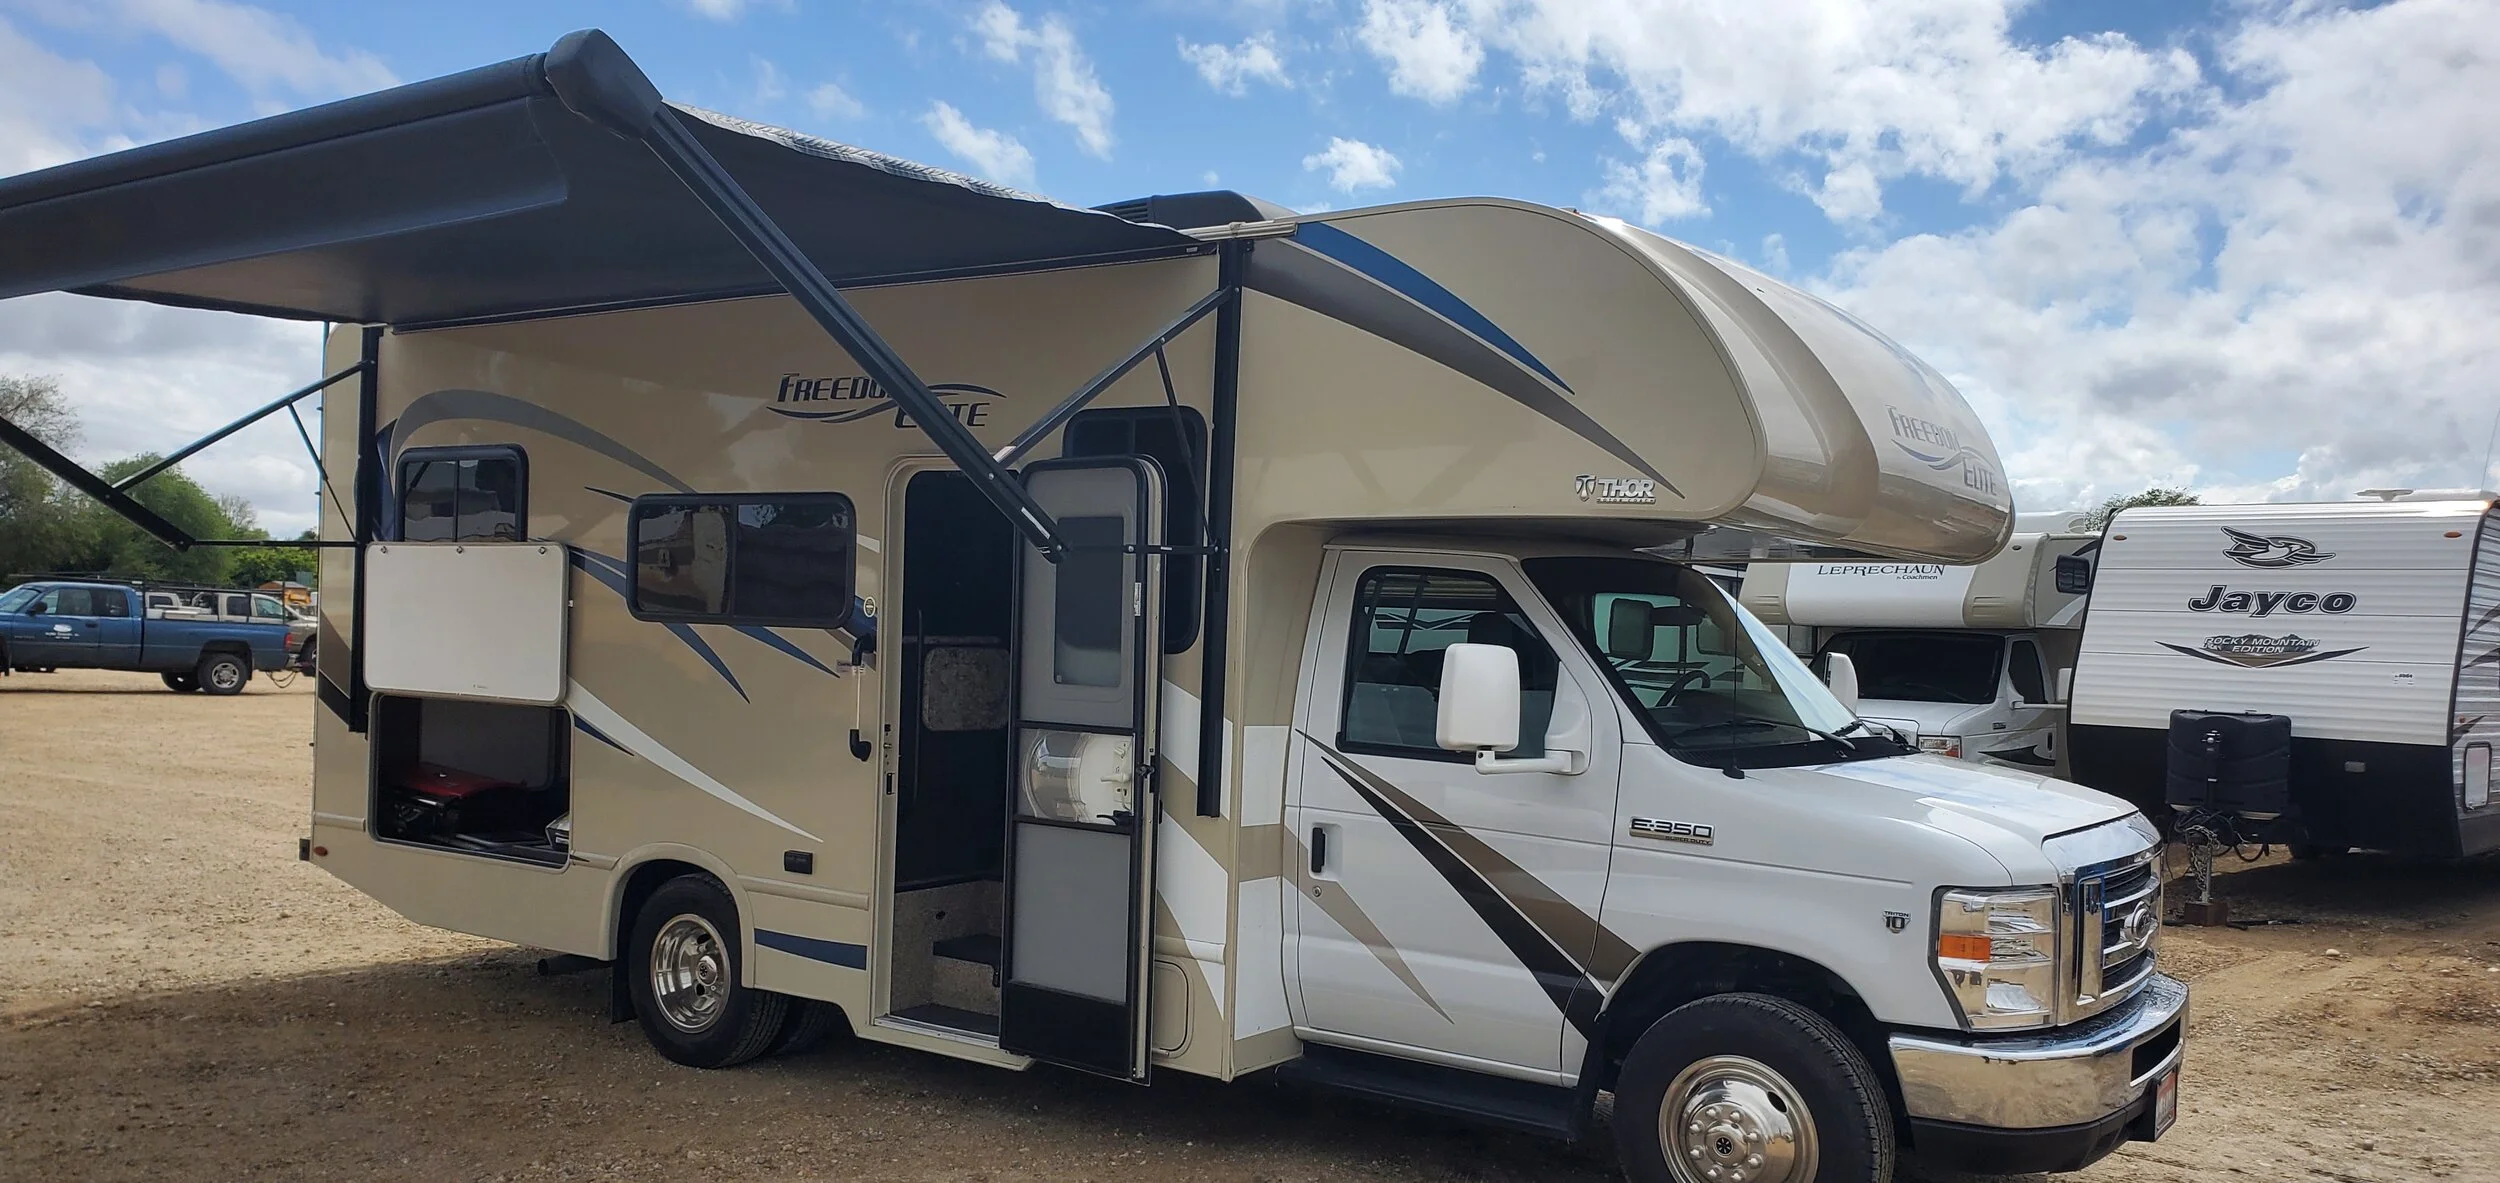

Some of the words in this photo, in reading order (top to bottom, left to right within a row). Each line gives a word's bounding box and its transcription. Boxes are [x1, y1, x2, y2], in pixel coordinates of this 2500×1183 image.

[777, 373, 887, 402] FREEDO
[1884, 404, 1961, 452] FREEDOM
[1962, 457, 1997, 496] ELITE
[1598, 478, 1656, 498] THOR
[1817, 564, 1945, 576] LEPRECHAUN
[2188, 584, 2357, 618] Jayco
[2204, 637, 2248, 646] ROCKY
[2251, 637, 2321, 647] MOUNTAIN
[2232, 645, 2285, 653] EDITION
[1631, 818, 1712, 838] E-350
[1883, 910, 1909, 918] TRITON
[1885, 916, 1905, 929] 10
